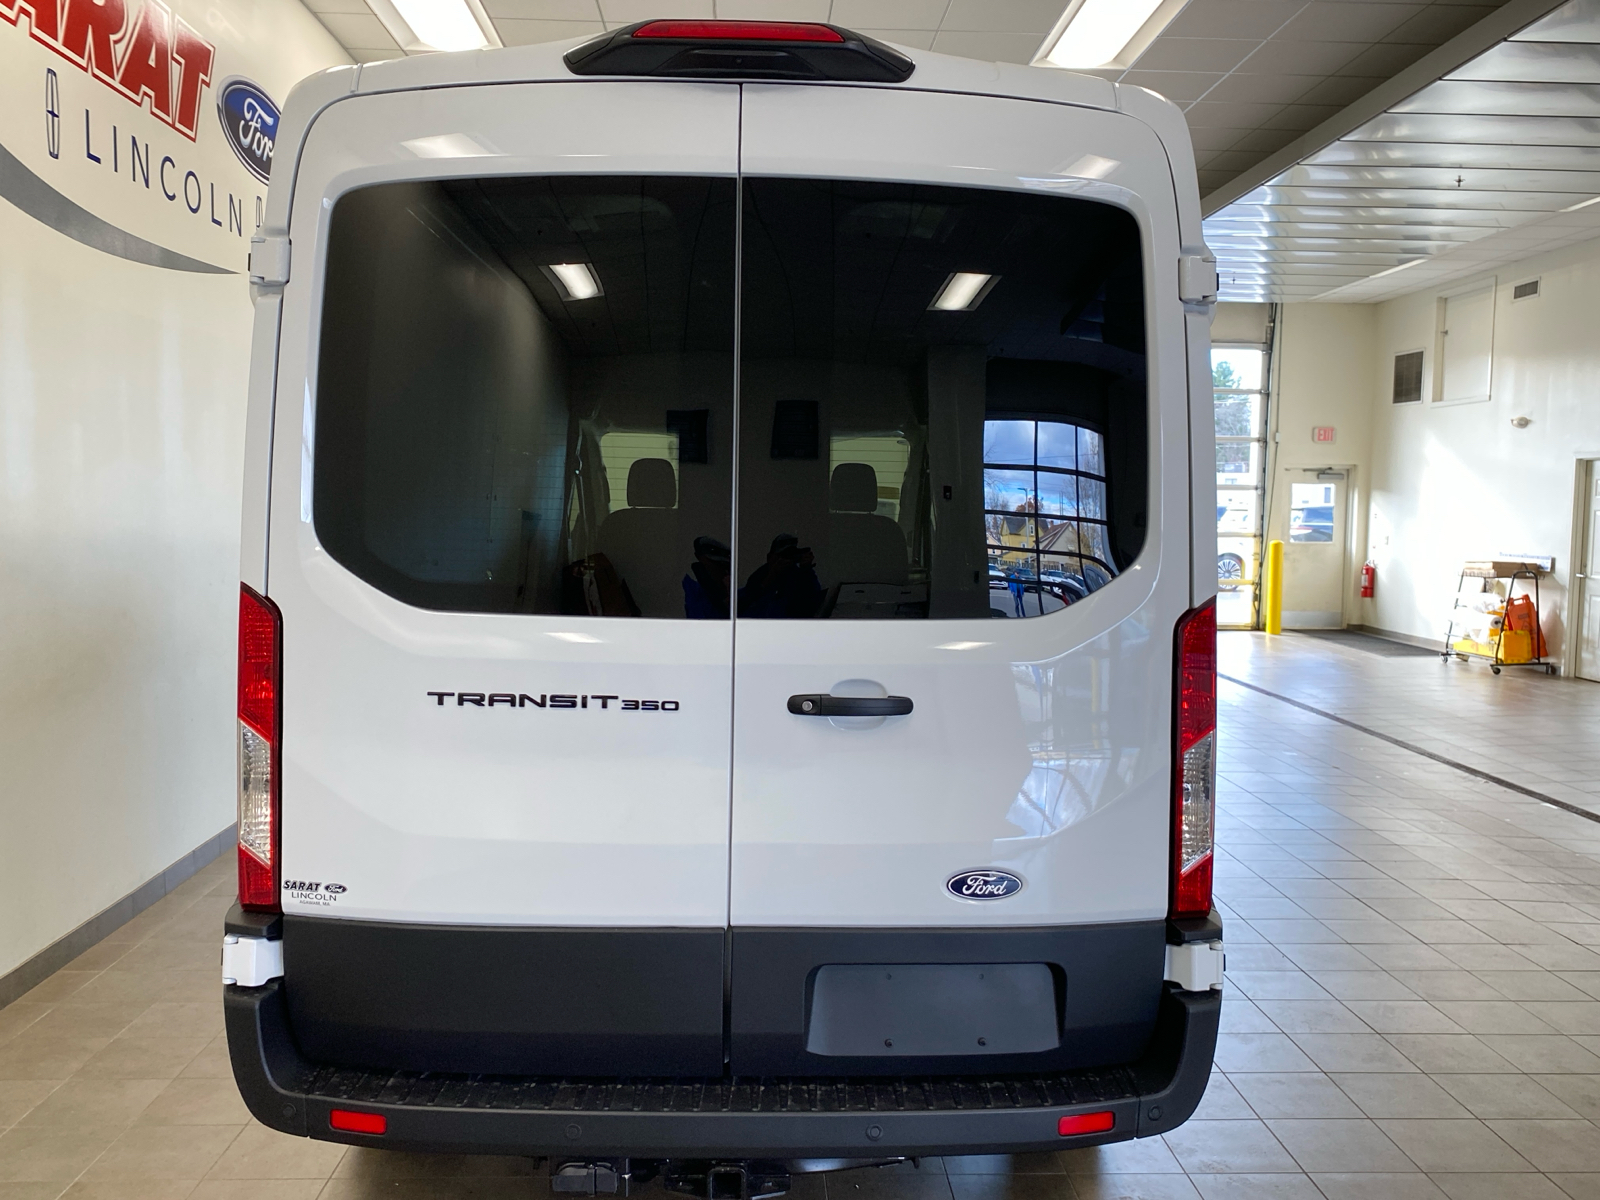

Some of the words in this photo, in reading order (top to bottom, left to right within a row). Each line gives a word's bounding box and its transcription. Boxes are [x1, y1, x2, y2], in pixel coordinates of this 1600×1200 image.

[238, 97, 274, 162] For
[84, 108, 243, 238] LINCOLN
[1317, 427, 1334, 441] EXIT
[283, 880, 322, 892] SARAT
[962, 875, 1008, 895] Ford
[291, 891, 337, 901] LINCOLN
